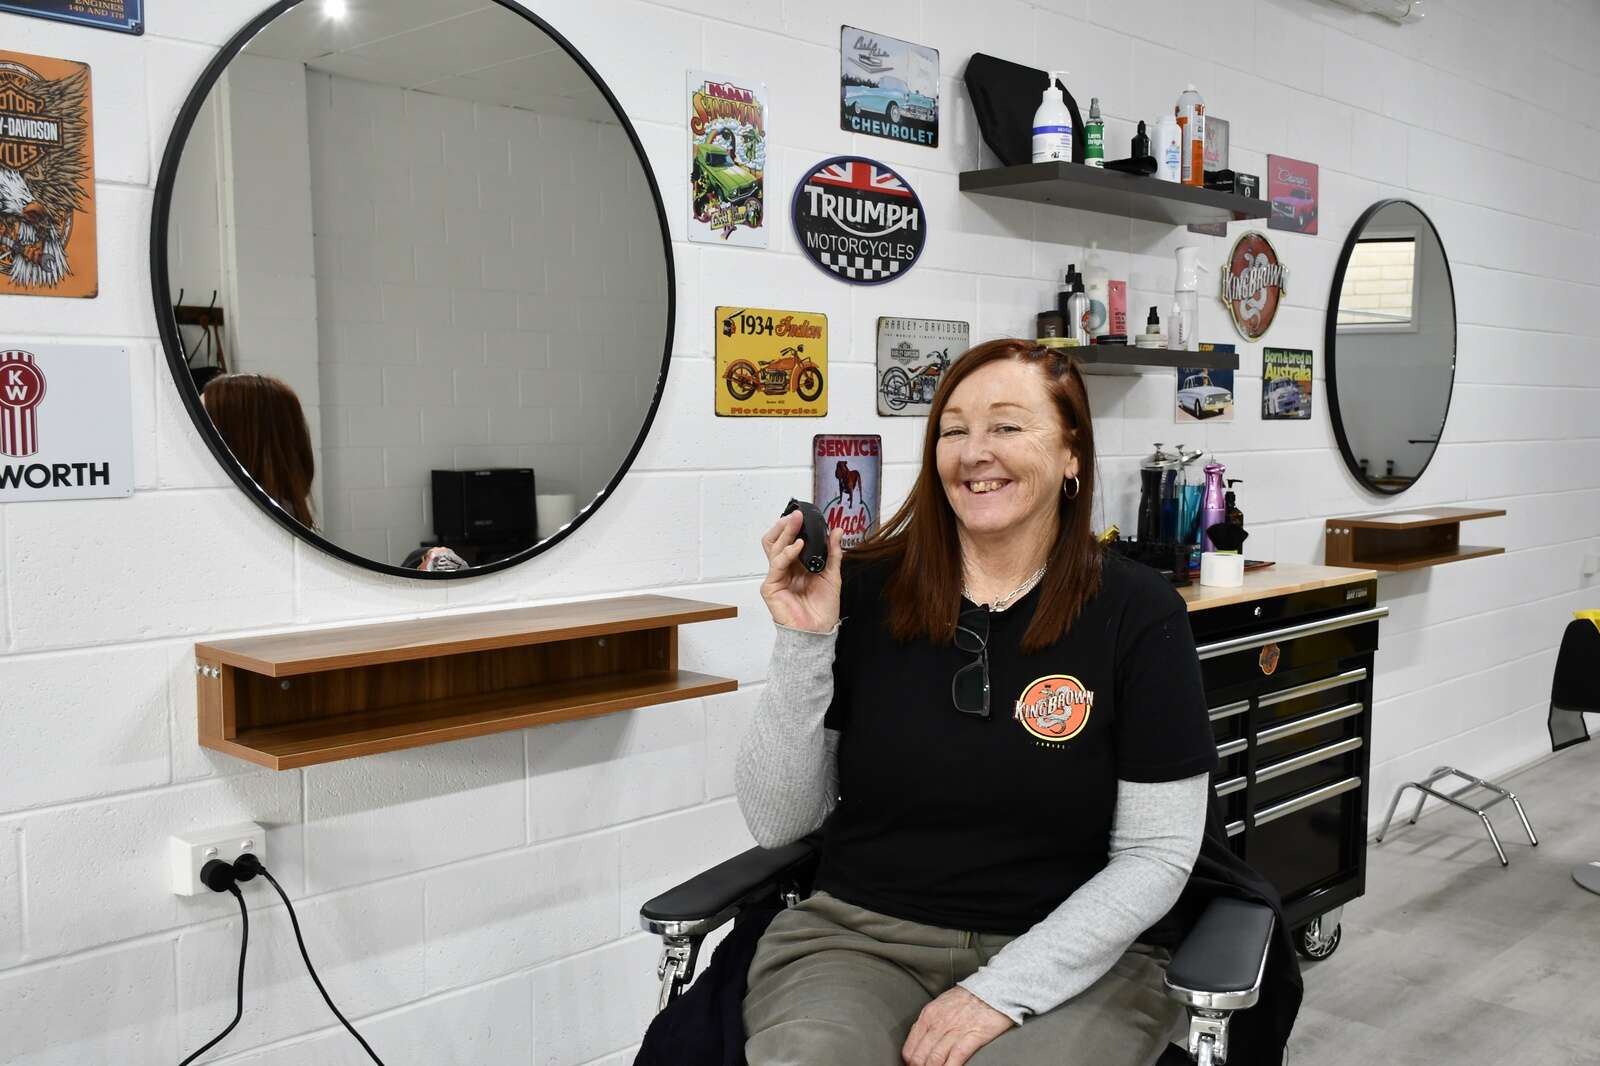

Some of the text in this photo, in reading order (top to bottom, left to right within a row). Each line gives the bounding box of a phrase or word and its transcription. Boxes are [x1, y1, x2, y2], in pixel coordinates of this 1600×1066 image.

[89, 8, 109, 17] AND
[851, 116, 934, 145] CHEVROLET
[804, 184, 918, 237] TRIUMPH
[807, 231, 914, 260] MOTORCYCLES
[740, 314, 774, 336] 1934
[8, 370, 24, 385] K
[1264, 363, 1312, 381] Australia
[5, 385, 28, 401] W
[730, 407, 818, 416] Motorcycles
[817, 439, 879, 457] SERVICE
[827, 506, 866, 535] Mack
